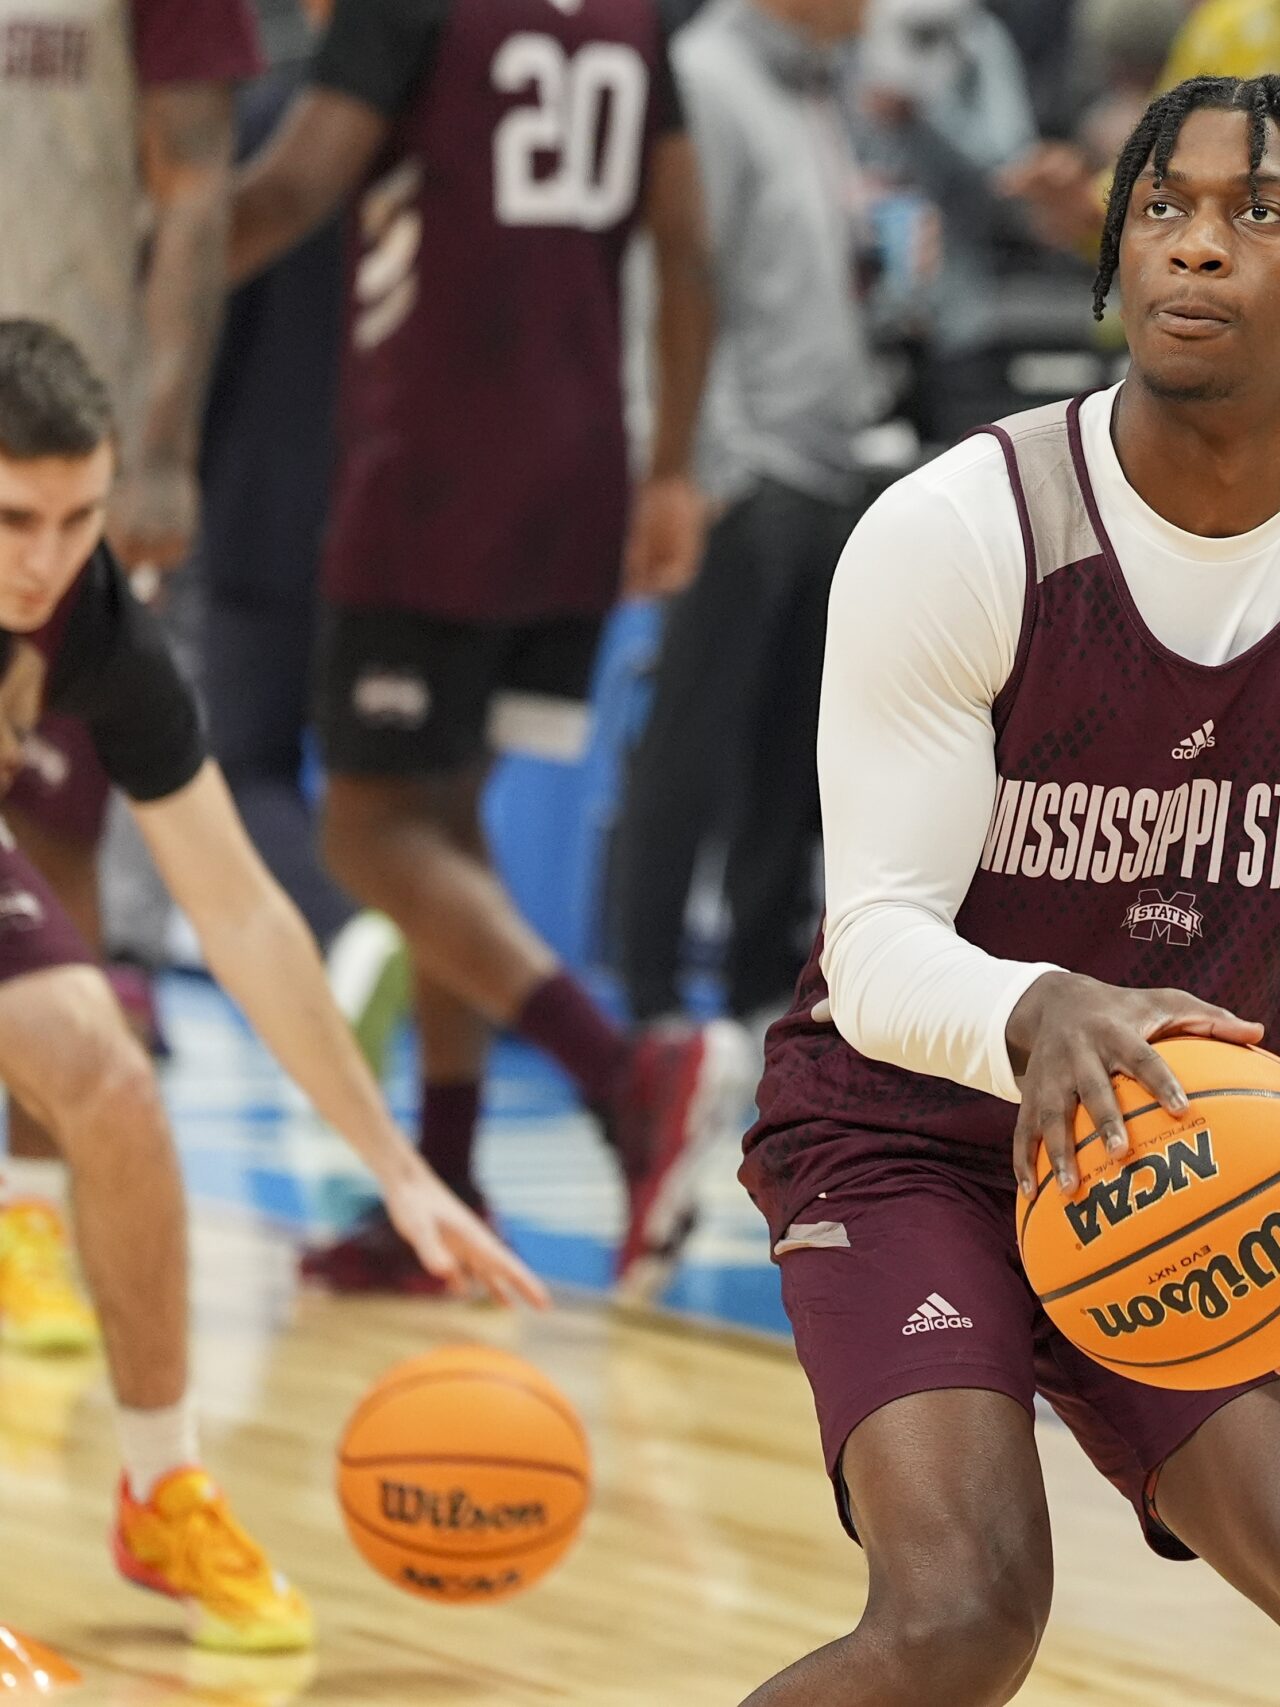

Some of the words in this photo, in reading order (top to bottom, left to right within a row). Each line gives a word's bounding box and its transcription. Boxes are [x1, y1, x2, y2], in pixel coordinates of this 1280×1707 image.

[492, 32, 648, 230] 20
[980, 774, 1232, 884] MISSISSIPPI
[1138, 905, 1188, 927] STATE
[1064, 1130, 1219, 1247] NCAA
[1180, 1244, 1211, 1267] EVO
[1147, 1264, 1178, 1285] NXT
[902, 1315, 973, 1335] adidas
[379, 1480, 546, 1530] Wilson
